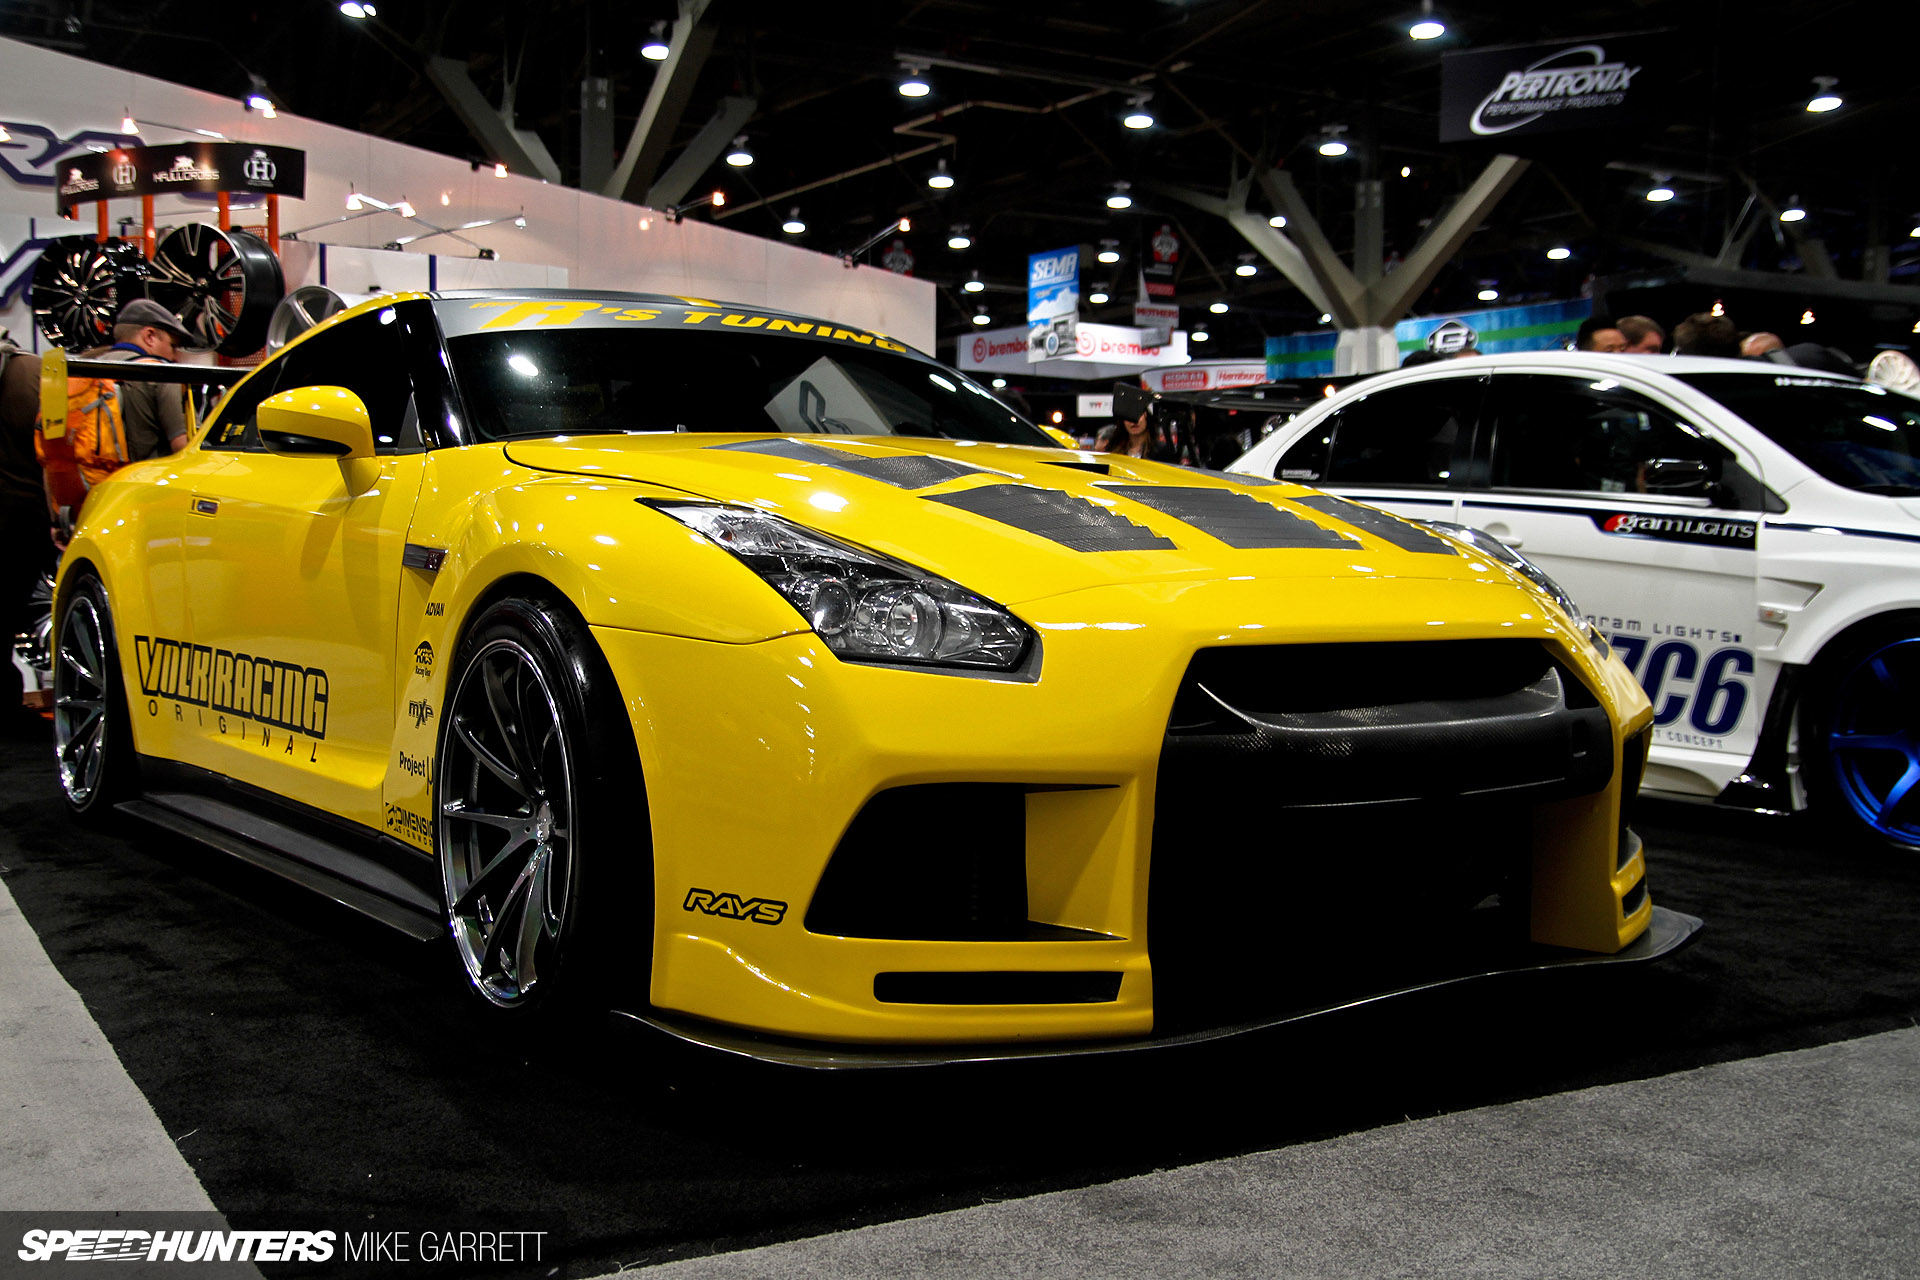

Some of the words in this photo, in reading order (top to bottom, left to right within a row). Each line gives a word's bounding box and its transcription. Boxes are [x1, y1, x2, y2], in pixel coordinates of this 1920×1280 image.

[1494, 61, 1642, 102] PERTRONIX
[1485, 97, 1563, 117] PERFORMANCE
[1565, 93, 1626, 110] PRODUCTS
[1032, 252, 1078, 281] SEMA
[683, 310, 907, 353] TUNING
[425, 601, 445, 617] ADVAN
[134, 634, 213, 707] VOLK
[212, 648, 329, 740] RACING
[147, 698, 318, 763] ORIGINAL
[1667, 731, 1723, 749] CONCEPT
[399, 750, 426, 777] Project
[682, 887, 789, 926] RAYS
